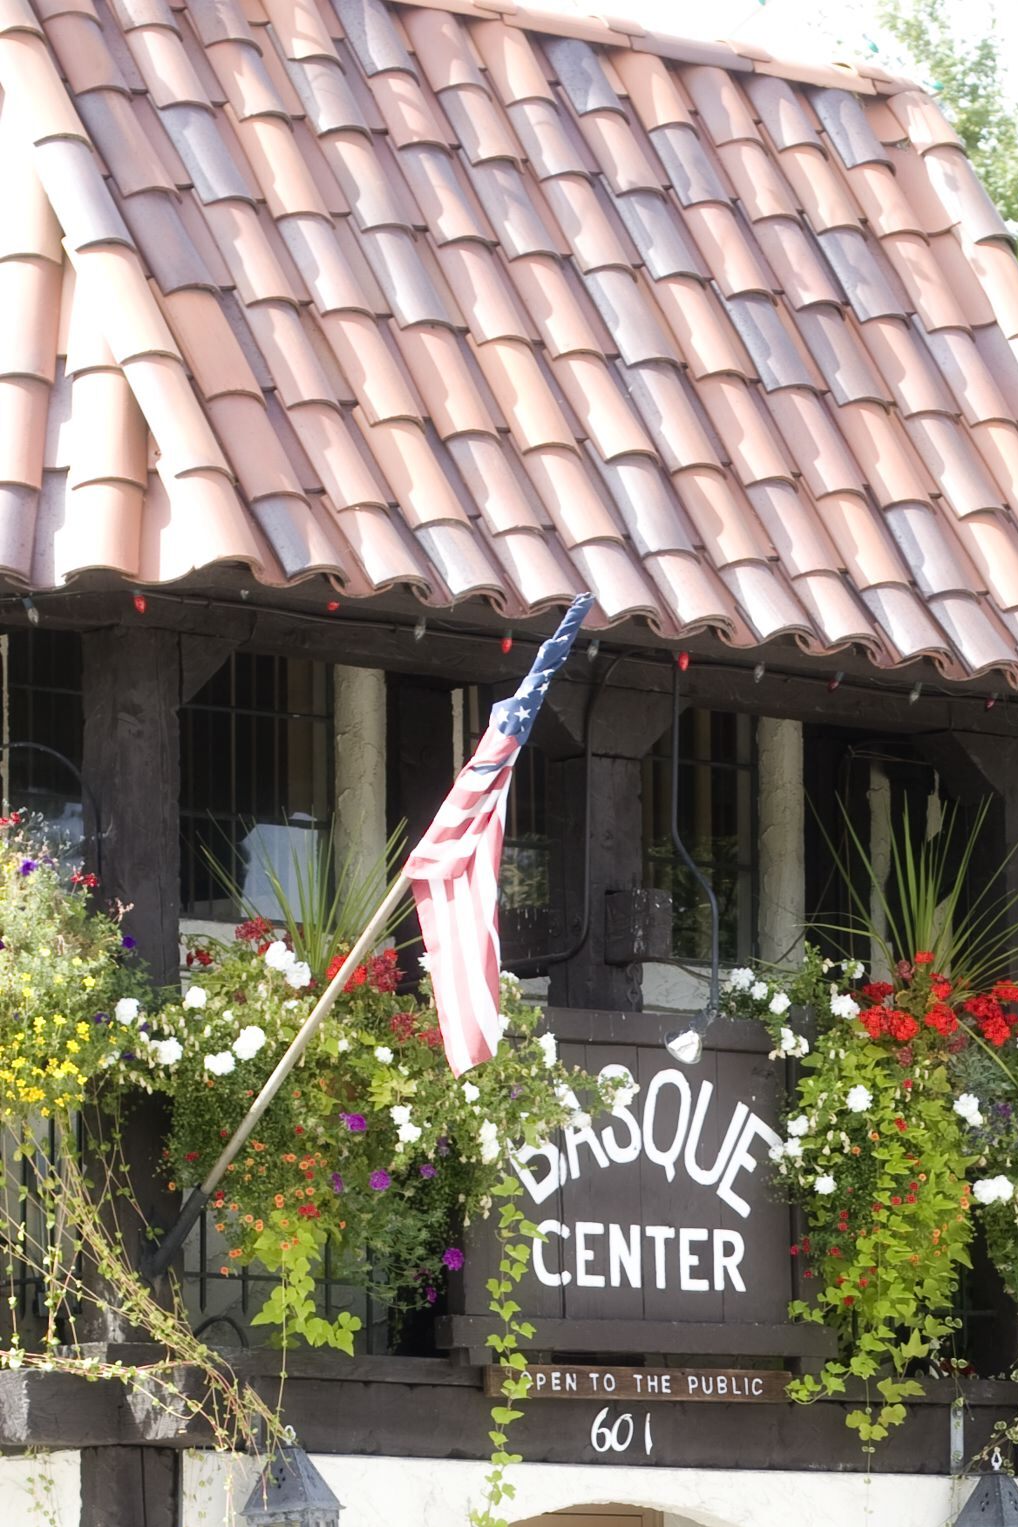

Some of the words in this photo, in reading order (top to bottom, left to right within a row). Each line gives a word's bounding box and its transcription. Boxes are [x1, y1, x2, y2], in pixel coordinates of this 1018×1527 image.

[506, 1063, 783, 1218] BASQUE
[532, 1219, 747, 1292] CENTER
[589, 1373, 616, 1392] TO
[633, 1374, 672, 1393] THE
[688, 1375, 764, 1396] PUBLIC
[591, 1407, 653, 1455] 601
